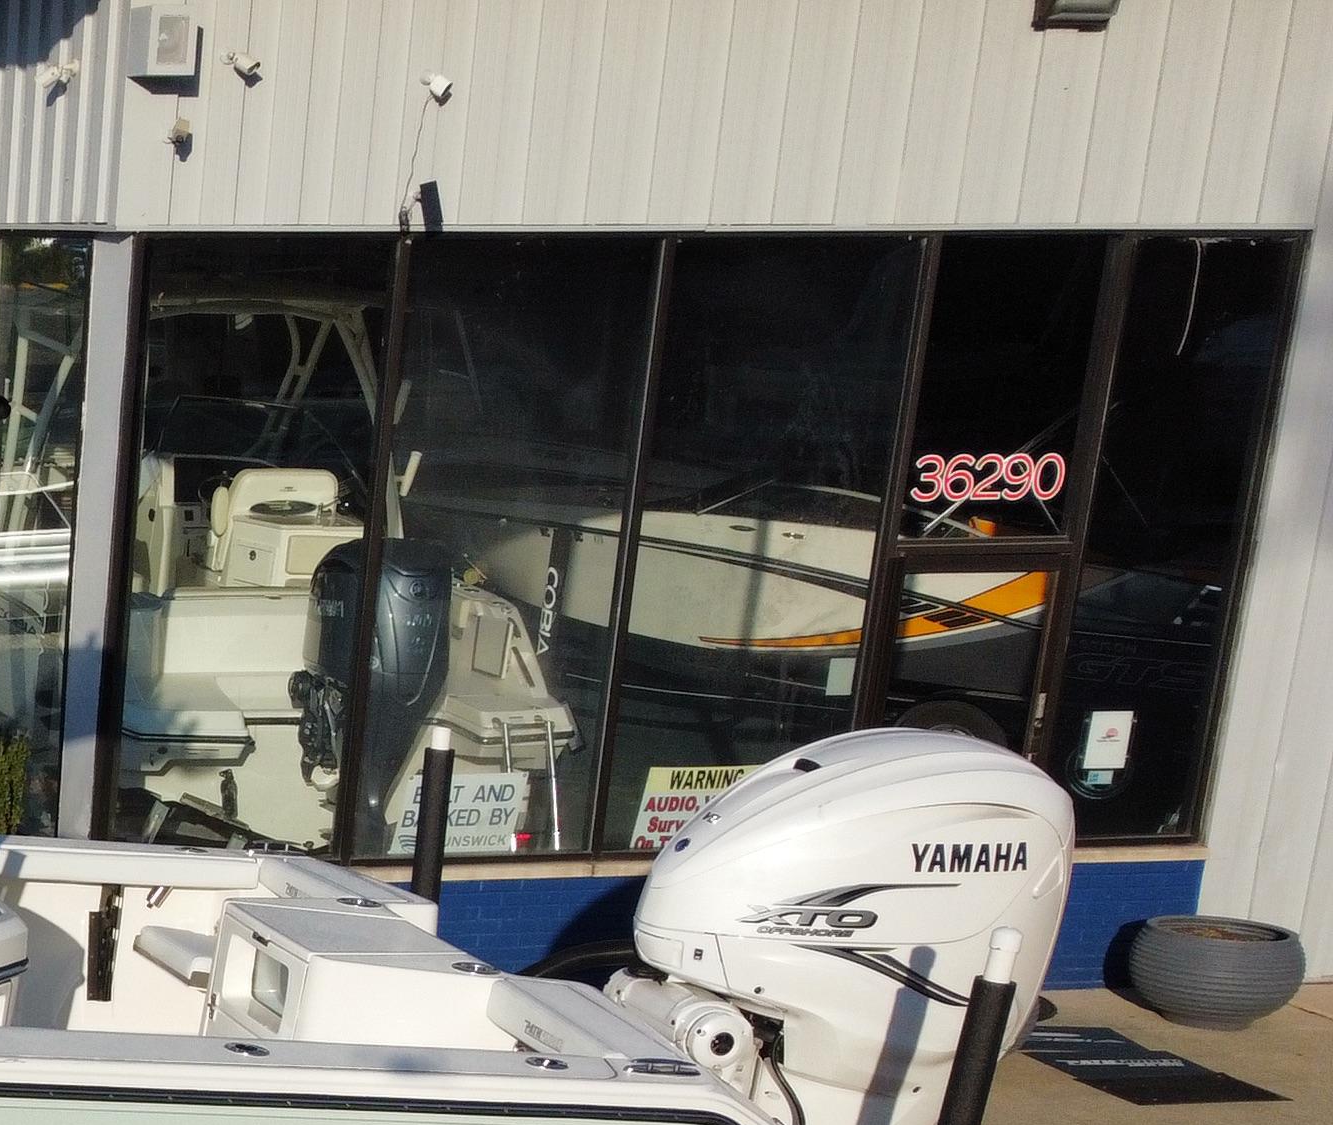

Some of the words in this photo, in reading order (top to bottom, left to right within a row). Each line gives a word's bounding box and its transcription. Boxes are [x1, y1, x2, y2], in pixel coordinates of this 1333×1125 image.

[910, 453, 1066, 502] 36290
[536, 567, 558, 655] COBIA
[472, 784, 516, 803] AND
[643, 795, 700, 813] AUDIO,
[401, 807, 481, 828] BKED
[488, 807, 516, 826] BY
[911, 842, 1028, 873] YAMAHA
[734, 903, 879, 929] XTO
[756, 927, 855, 938] OFFSHORE
